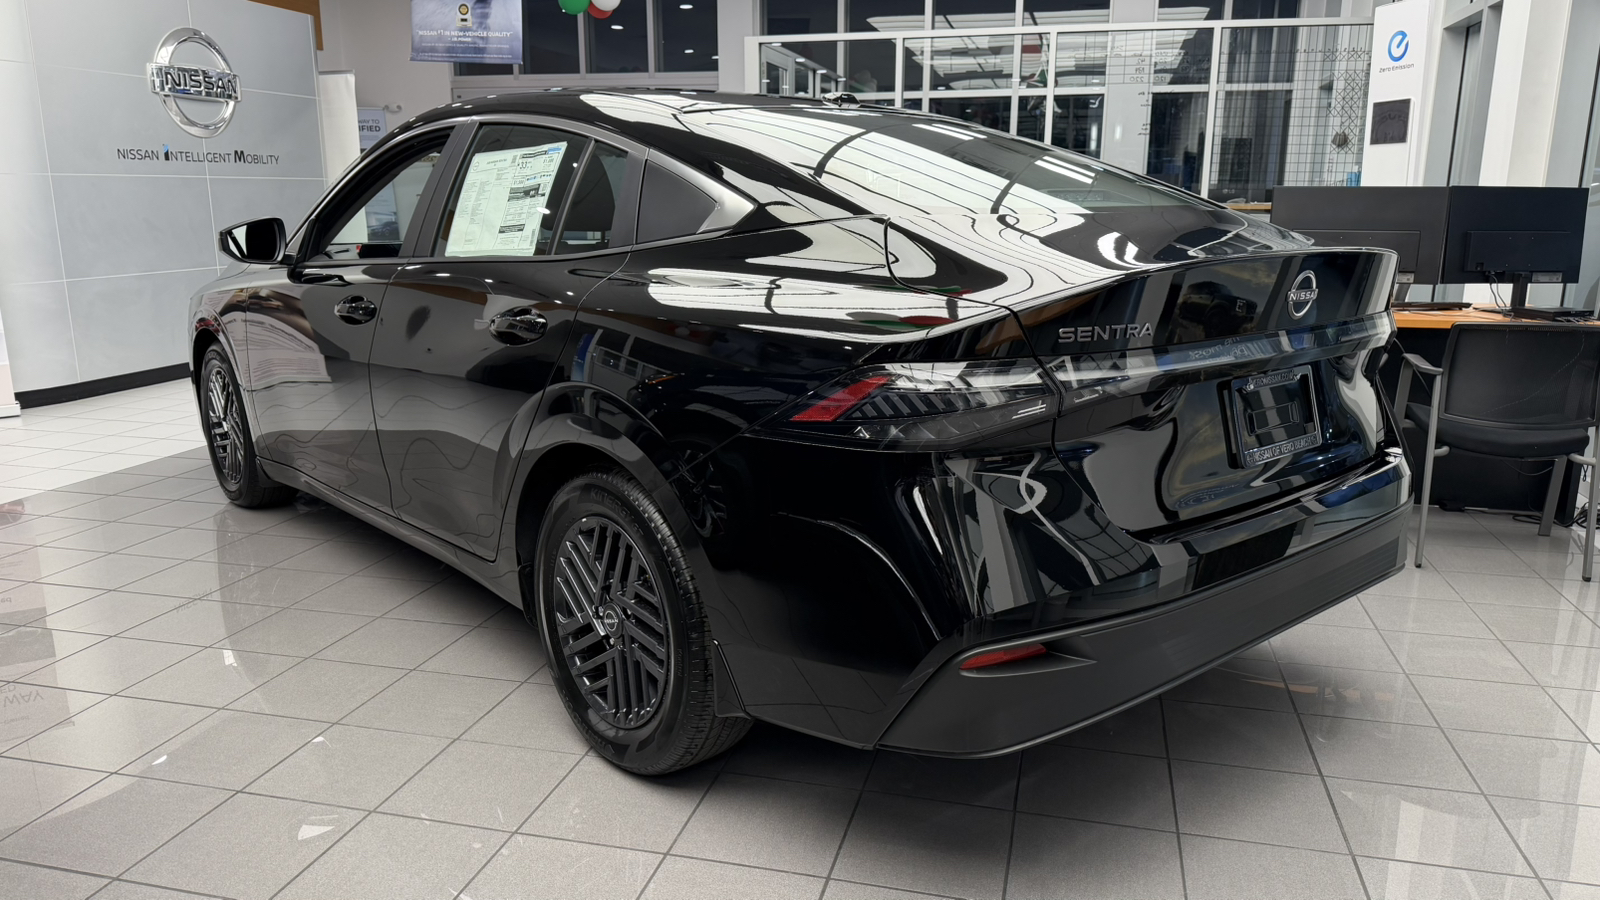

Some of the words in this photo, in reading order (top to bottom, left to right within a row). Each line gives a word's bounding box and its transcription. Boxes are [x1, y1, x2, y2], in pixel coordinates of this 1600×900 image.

[164, 71, 237, 94] NISSAN
[117, 149, 160, 161] NISSAN
[164, 144, 232, 164] INTELLIGENT
[234, 150, 280, 164] MOBILITY
[1290, 291, 1316, 301] NISSA
[1058, 323, 1154, 343] SENTRA
[1253, 449, 1273, 461] NISSAN
[1273, 446, 1280, 456] OF
[1281, 442, 1294, 453] VERO
[1294, 437, 1312, 450] BEACH
